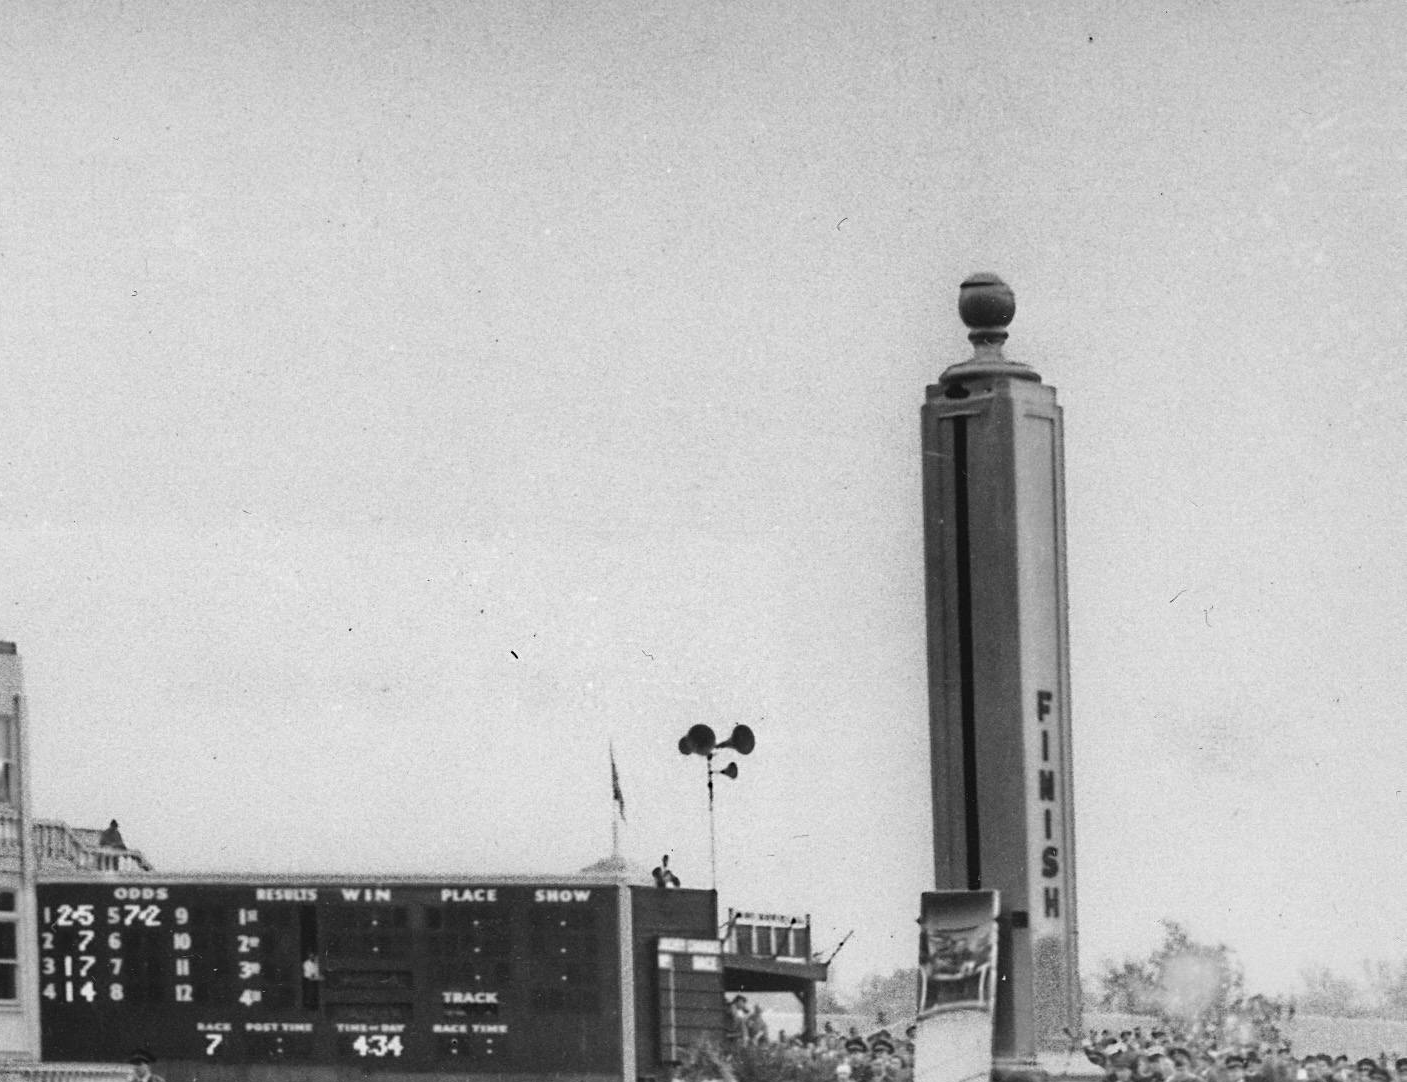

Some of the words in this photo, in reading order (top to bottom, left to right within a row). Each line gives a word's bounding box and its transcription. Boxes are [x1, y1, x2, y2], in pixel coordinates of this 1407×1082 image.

[1036, 690, 1060, 918] FINISH
[113, 887, 169, 900] ODDS
[256, 888, 318, 901] RESULTS
[342, 888, 391, 902] WIN
[441, 889, 497, 902] PLACE
[535, 889, 591, 903] SHOW
[44, 906, 51, 924] 1
[107, 906, 120, 924] 5
[175, 907, 189, 925] 9
[42, 932, 54, 949] 2
[78, 930, 94, 951] 7
[108, 932, 121, 949] 6
[173, 932, 191, 950] 10
[43, 957, 55, 974] 3
[110, 958, 123, 975] 7
[176, 958, 190, 976] 11
[43, 983, 56, 999] 4
[110, 983, 124, 1000] 8
[175, 984, 193, 1001] 12
[442, 992, 498, 1004] TRACK
[197, 1022, 232, 1031] RACE
[245, 1022, 278, 1032] POST
[281, 1022, 313, 1032] TIME
[336, 1023, 367, 1032] TIME
[381, 1023, 405, 1032] DAY
[432, 1024, 467, 1033] RACE
[471, 1024, 508, 1033] TIME
[205, 1034, 223, 1056] 7
